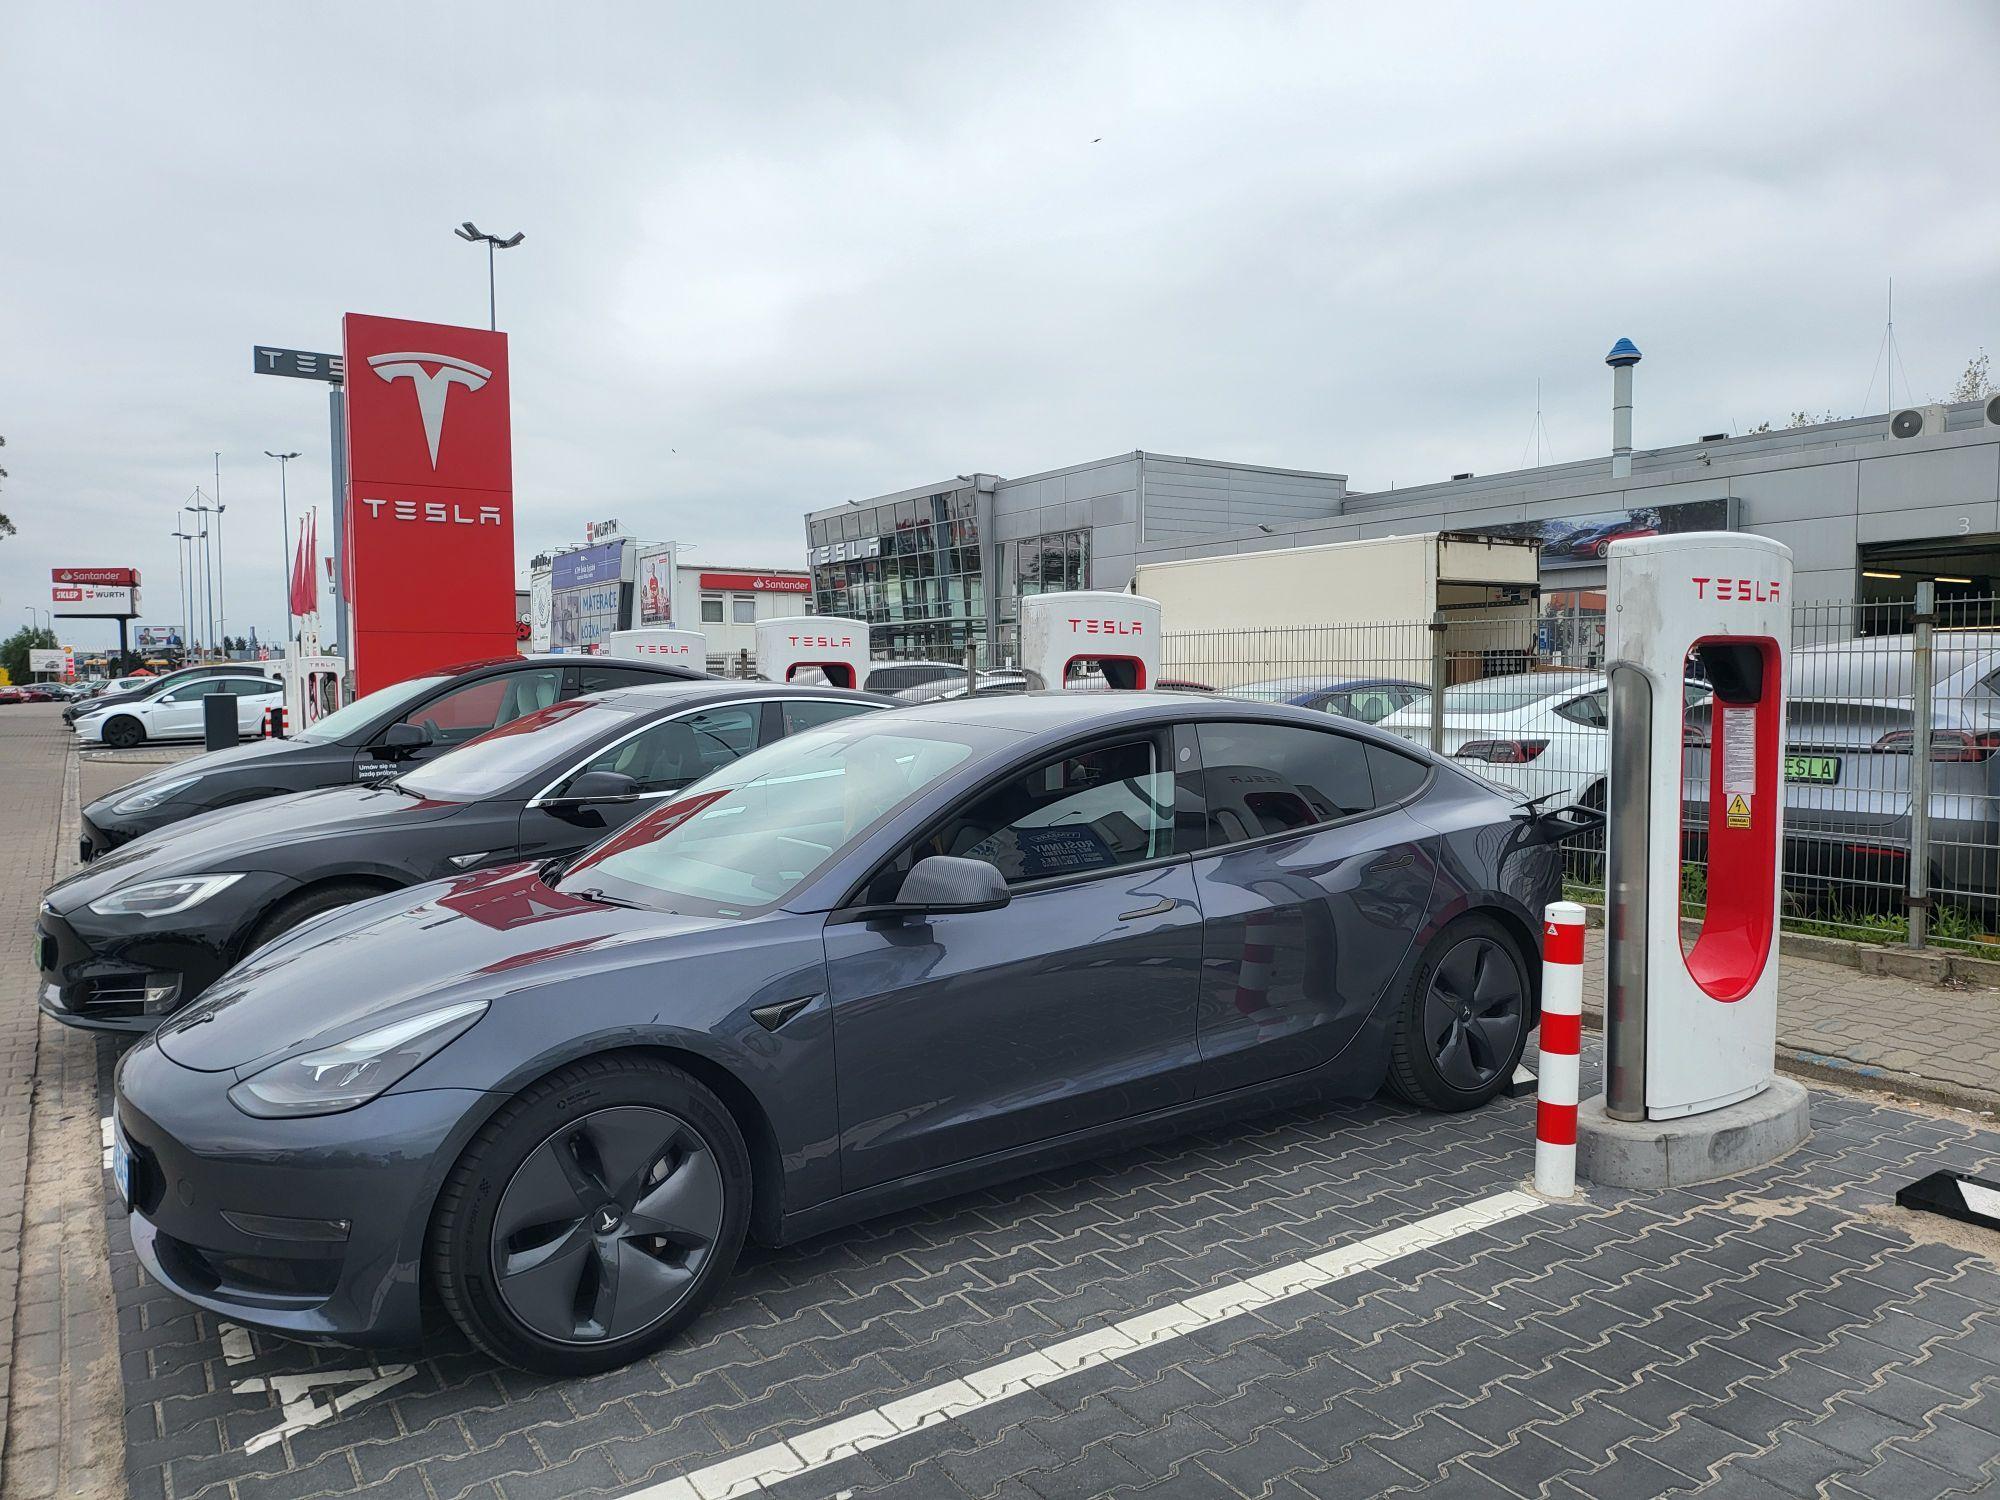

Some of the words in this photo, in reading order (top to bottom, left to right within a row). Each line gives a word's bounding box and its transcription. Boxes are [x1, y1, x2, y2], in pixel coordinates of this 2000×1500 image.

[362, 498, 501, 526] TESLA
[1958, 517, 1970, 535] 3
[806, 536, 880, 566] TESLA
[73, 571, 120, 580] Santander
[765, 579, 809, 590] Santander
[1692, 578, 1781, 602] TESLA
[56, 591, 79, 599] SKLEP
[582, 591, 618, 611] MATERACE
[1068, 618, 1143, 635] TESLA
[636, 644, 689, 654] TESLA
[788, 636, 852, 648] TESLA
